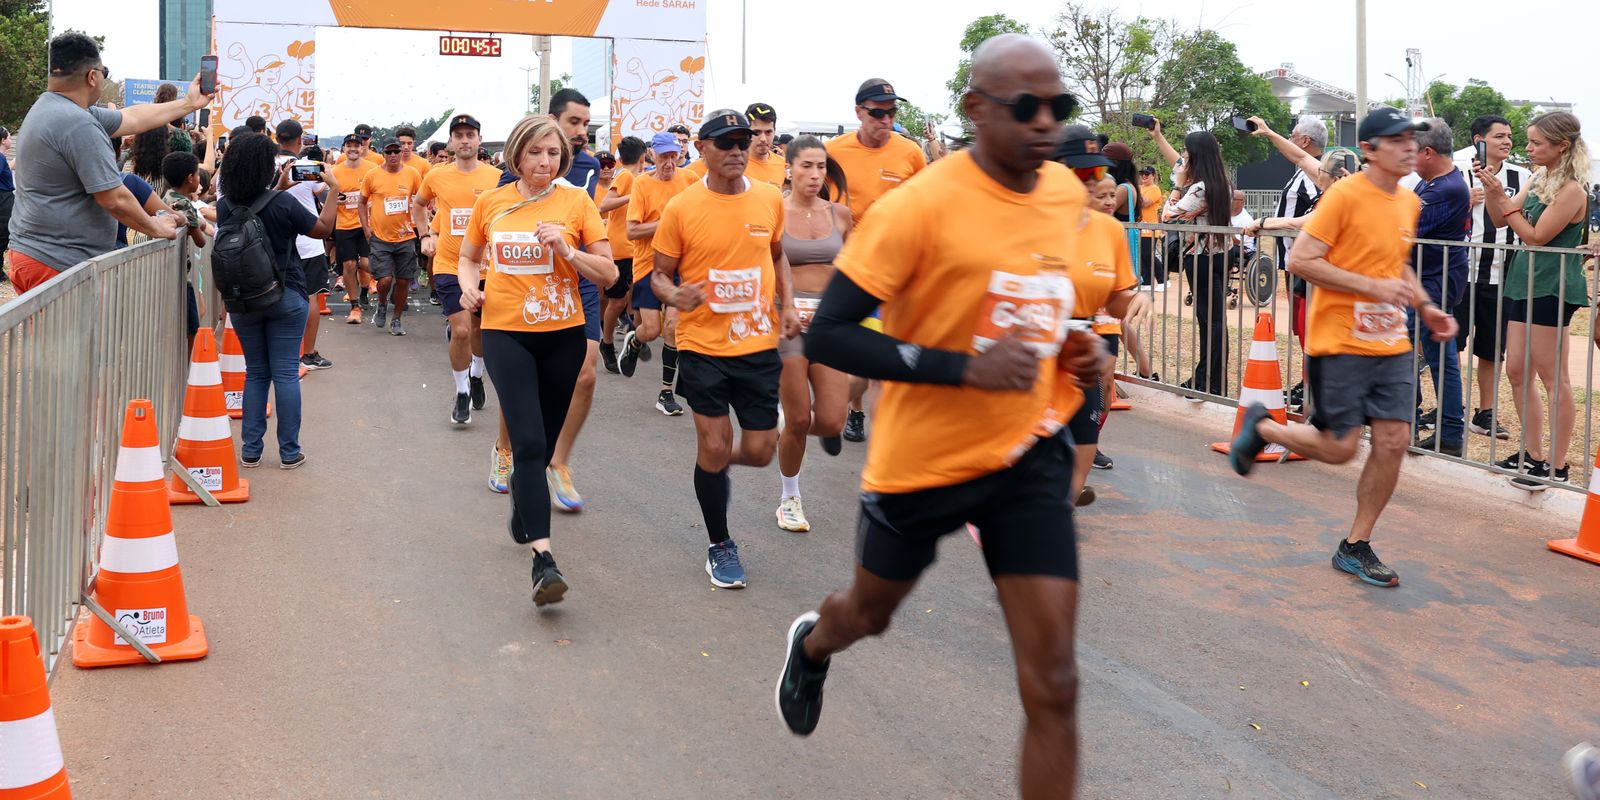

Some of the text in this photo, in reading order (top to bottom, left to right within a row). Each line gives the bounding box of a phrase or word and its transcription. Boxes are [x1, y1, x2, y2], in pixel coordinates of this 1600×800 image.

[662, 0, 696, 9] SARAH
[441, 37, 500, 55] 00:04:52
[300, 91, 314, 106] 12
[255, 103, 271, 120] 3
[691, 104, 704, 118] 12
[650, 115, 665, 131] 3
[725, 115, 739, 126] H
[388, 201, 405, 210] 3911
[455, 216, 470, 226] 67
[501, 244, 543, 260] 6040
[713, 283, 754, 299] 6045
[205, 467, 221, 476] Bruno
[143, 610, 165, 621] Bruno
[139, 625, 165, 636] Atleta
